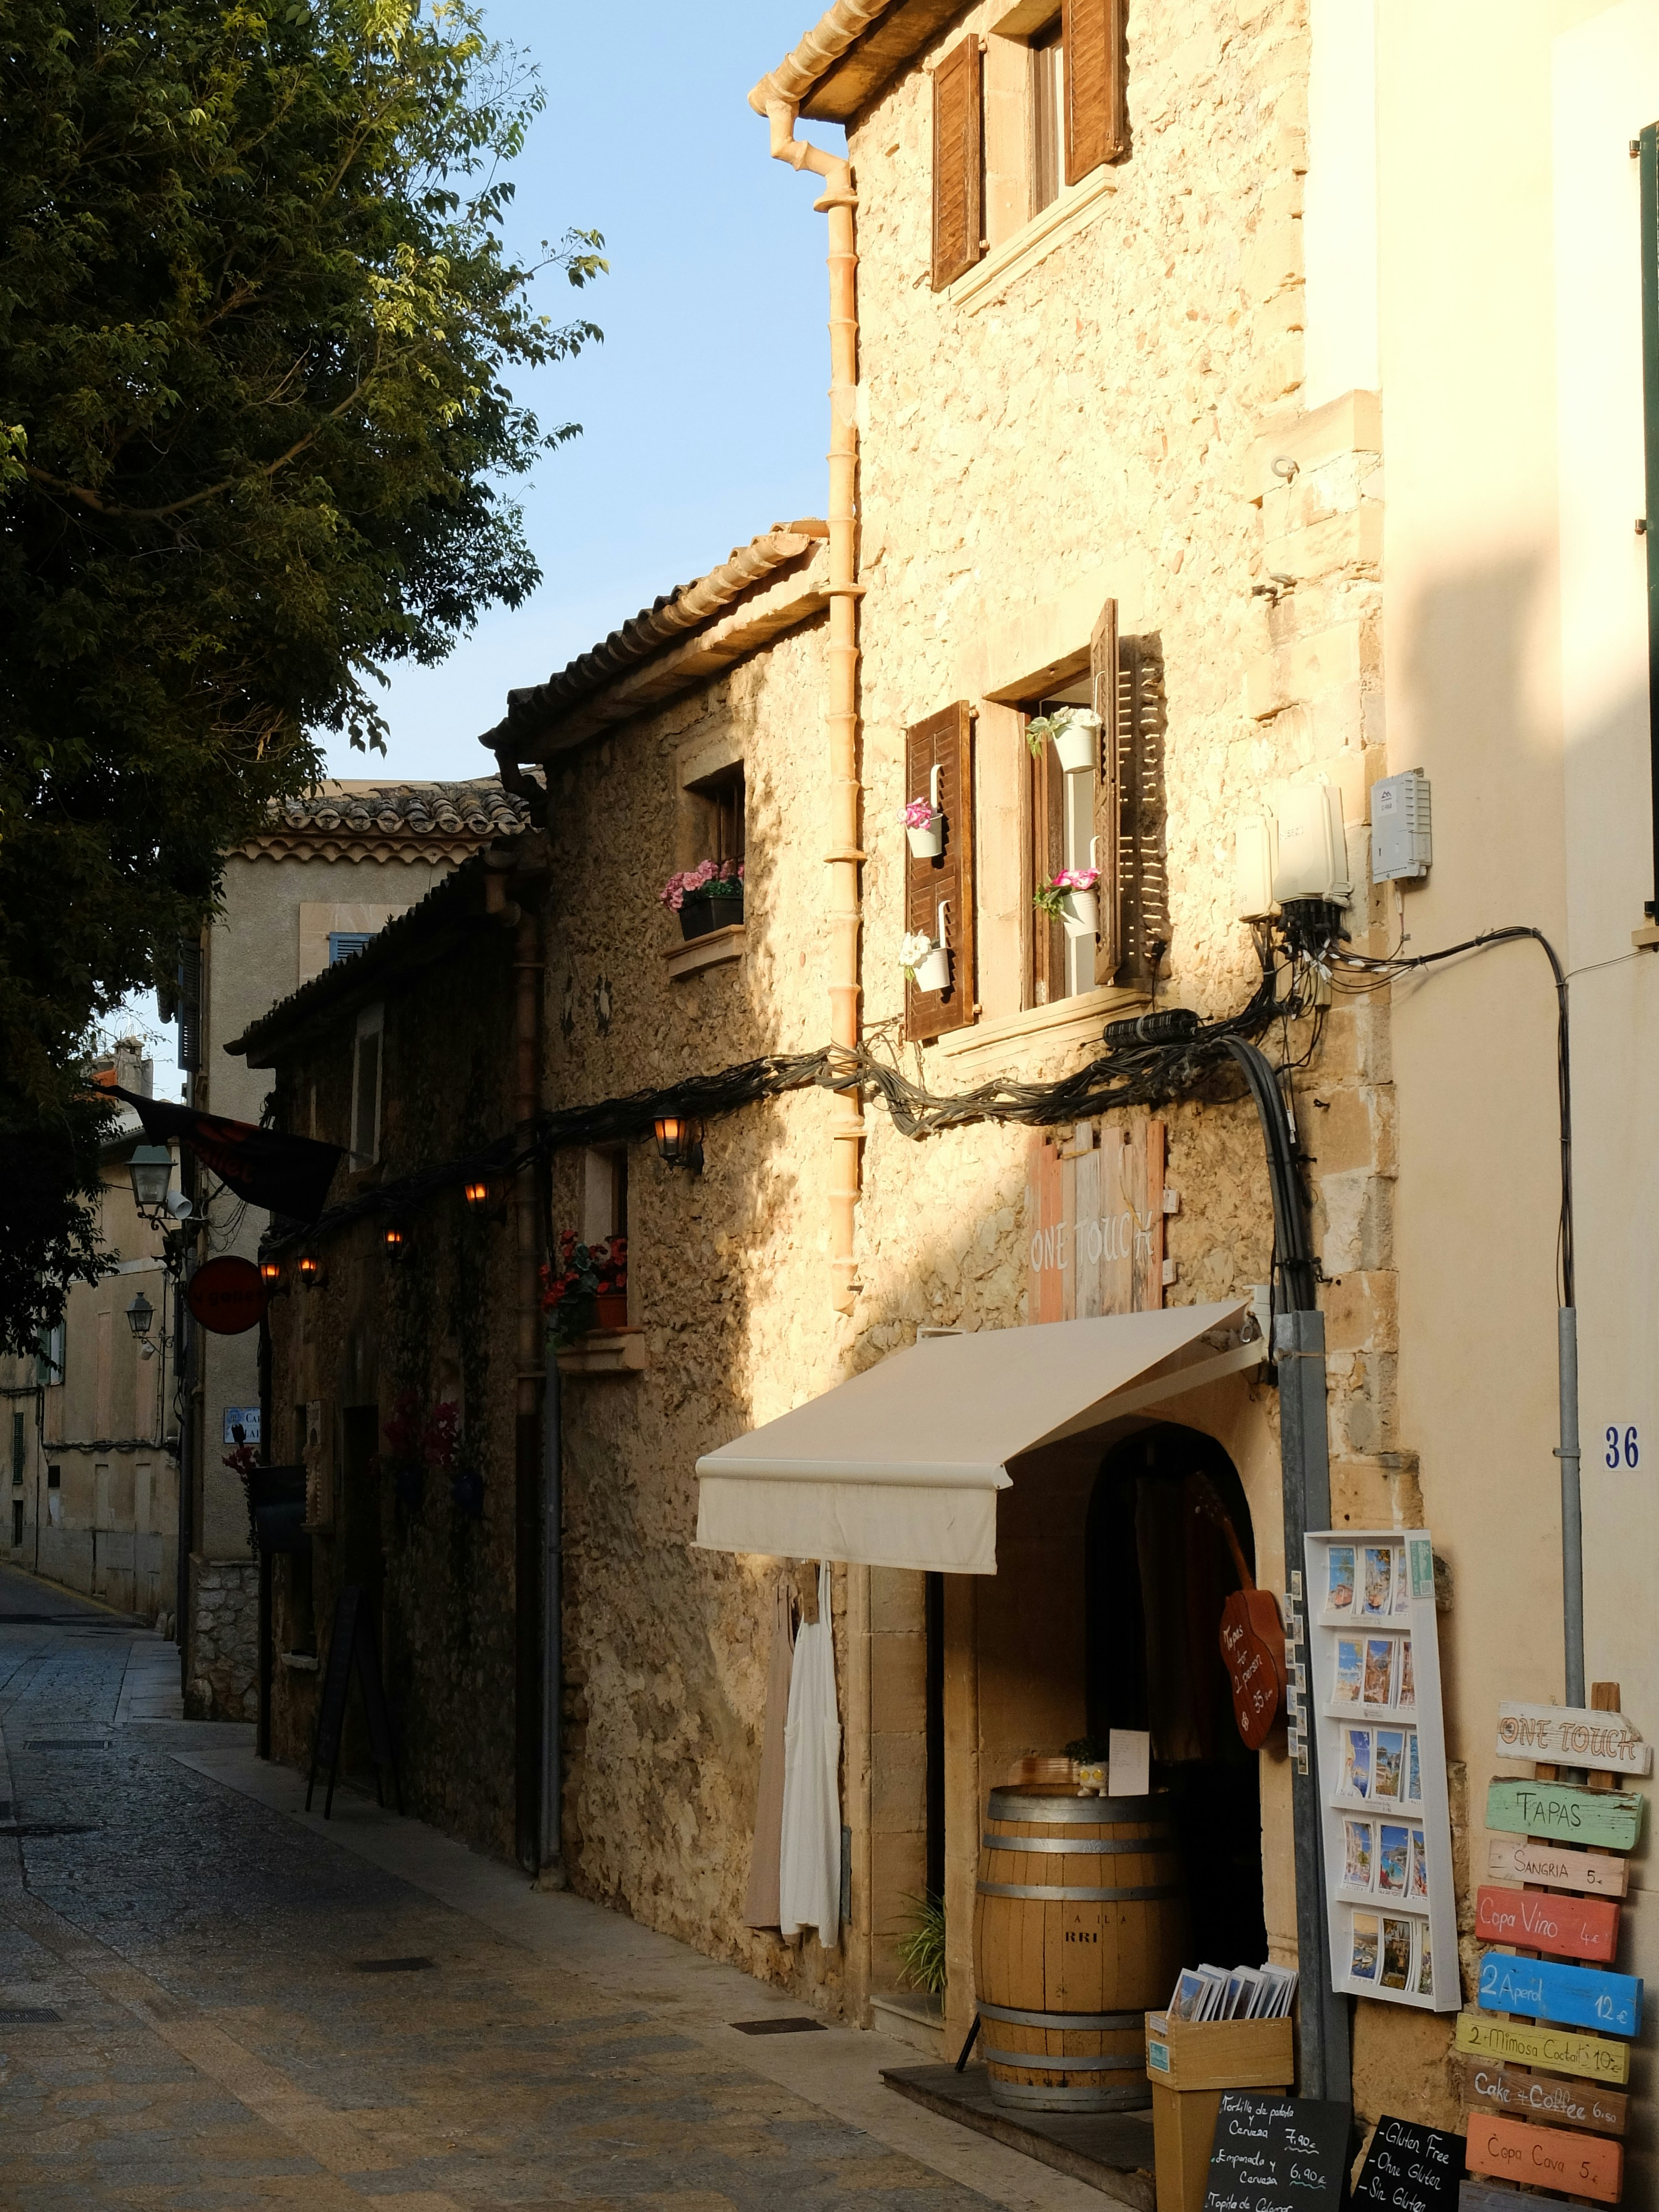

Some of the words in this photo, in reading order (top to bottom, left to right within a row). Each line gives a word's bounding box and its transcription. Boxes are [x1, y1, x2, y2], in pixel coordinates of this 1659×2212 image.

[1031, 1221, 1068, 1273] ONE
[1074, 1210, 1154, 1265] TOUCH
[1605, 1426, 1639, 1469] 36
[1223, 1625, 1244, 1651] Tapas
[1243, 1655, 1263, 1691] person
[1253, 1690, 1264, 1713] 35
[1500, 1717, 1551, 1749] ONE
[1558, 1723, 1636, 1760] TOUCH
[1516, 1792, 1582, 1828] TAPAS
[1514, 1849, 1569, 1877] SANGRIA
[1480, 1897, 1516, 1933] Copa
[1521, 1902, 1558, 1938] Vino
[1480, 1964, 1498, 1995] 2
[1499, 1974, 1543, 2006] Aperol
[1222, 2095, 1253, 2114] Tortilla
[1255, 2103, 1268, 2115] de
[1475, 2072, 1511, 2103] Cake
[1530, 2084, 1587, 2121] Coffee
[1229, 2120, 1268, 2138] Cerveza
[1215, 2148, 1265, 2168] Empanada
[1426, 2134, 1449, 2164] Free
[1488, 2136, 1521, 2165] Copa
[1532, 2145, 1565, 2173] Cava
[1239, 2171, 1278, 2185] Cerveza
[1408, 2163, 1442, 2190] Gluten
[1239, 2196, 1250, 2209] de
[1392, 2187, 1426, 2212] Gluten
